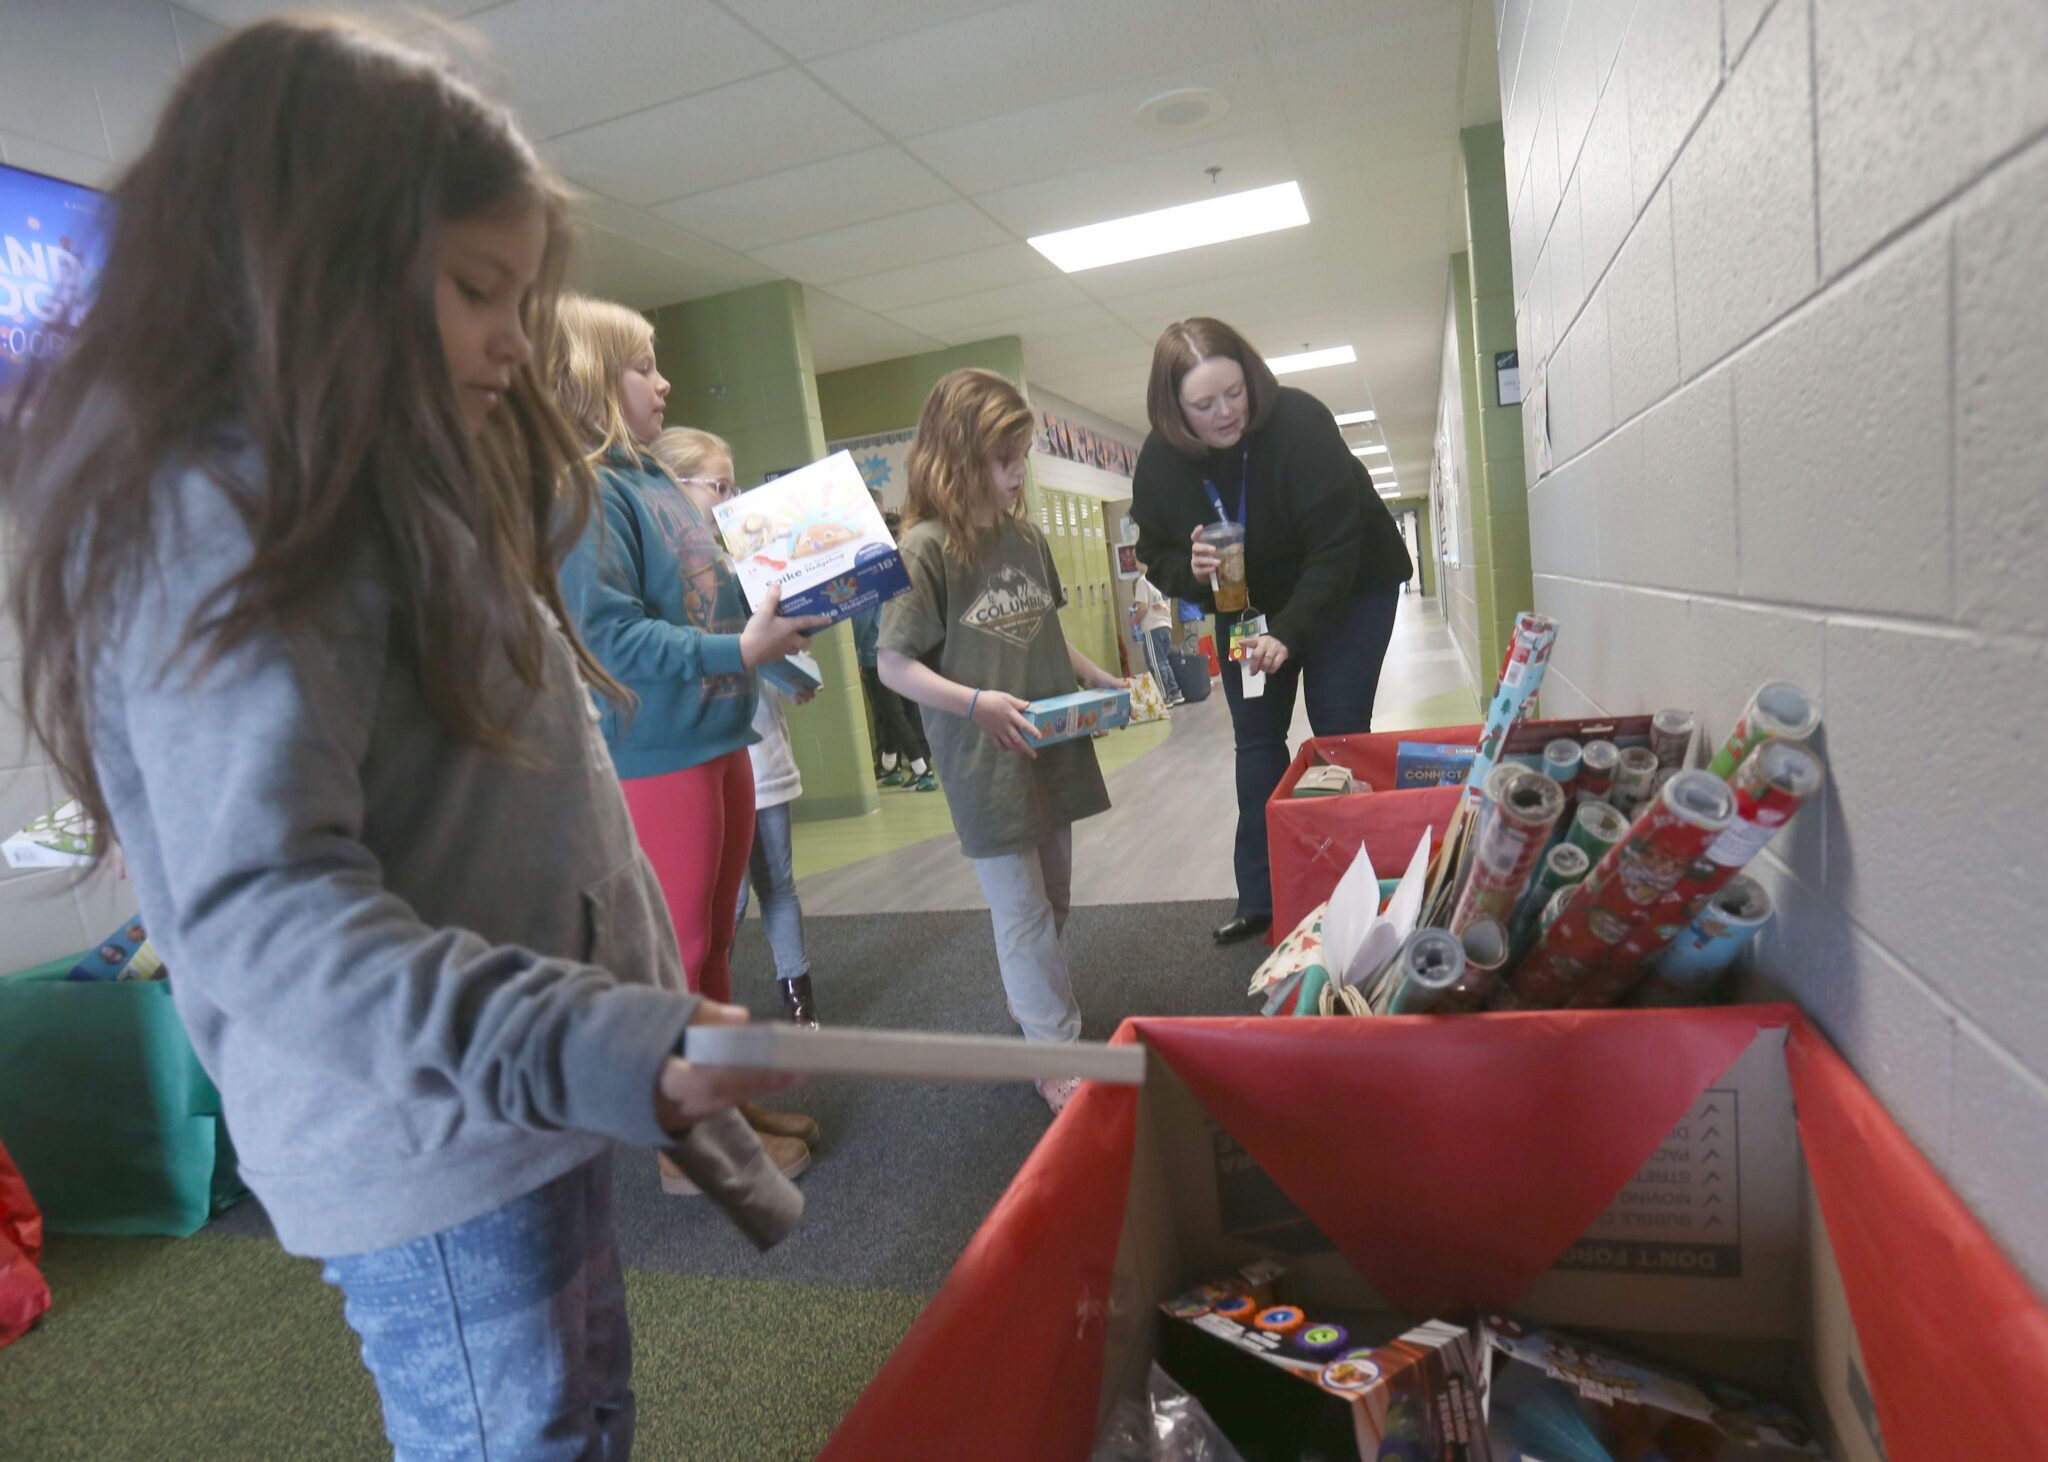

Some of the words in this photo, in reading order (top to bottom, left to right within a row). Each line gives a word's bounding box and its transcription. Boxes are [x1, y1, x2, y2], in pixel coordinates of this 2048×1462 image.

[878, 556, 898, 572] 18+
[1405, 769, 1462, 780] CONNECT
[1637, 1249, 1715, 1269] DON'T
[1437, 1392, 1456, 1443] TRUCK
